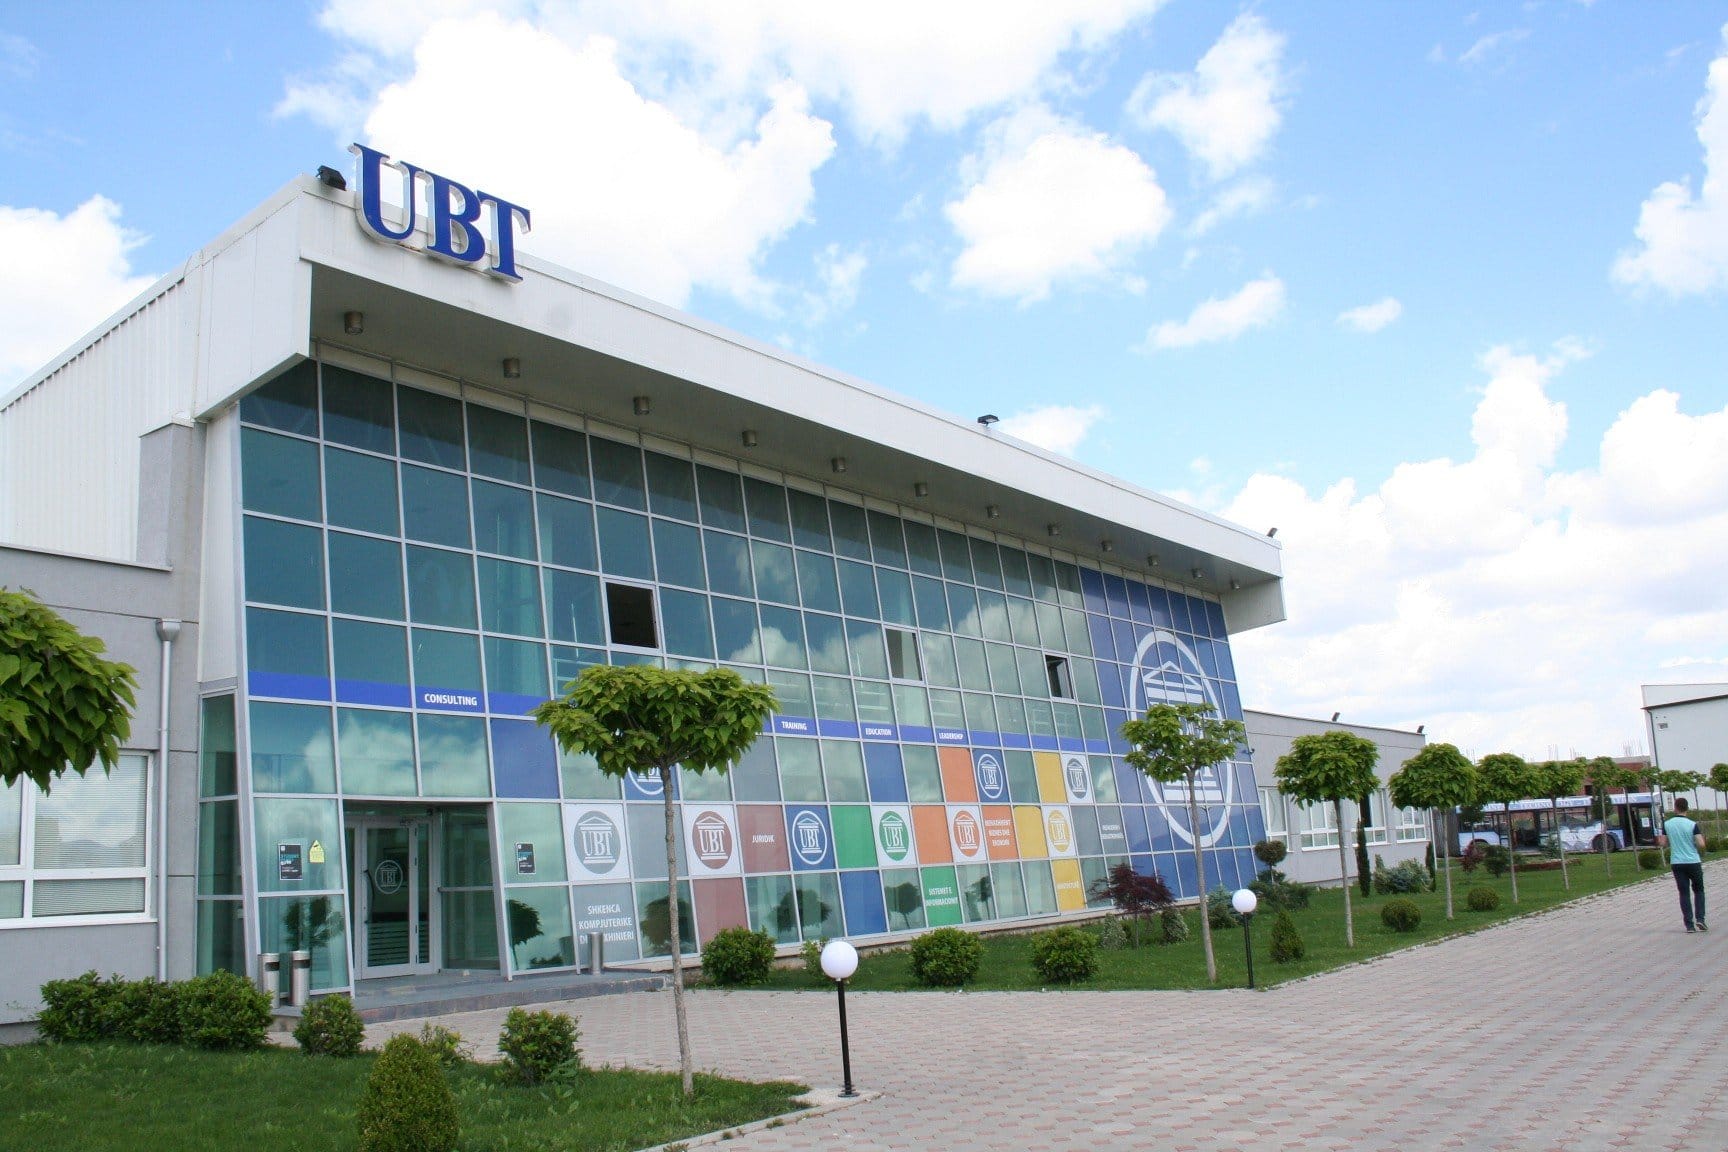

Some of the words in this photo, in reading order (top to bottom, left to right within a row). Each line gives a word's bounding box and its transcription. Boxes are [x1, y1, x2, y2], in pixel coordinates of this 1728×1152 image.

[349, 142, 531, 284] UBT
[424, 692, 478, 706] CONSULTING
[781, 720, 807, 731] TRAINING
[865, 727, 892, 737] EDUCATION
[982, 768, 998, 785] UBT
[581, 830, 613, 856] UBT
[699, 829, 725, 853] UBT
[799, 828, 820, 848] UBT
[883, 826, 904, 847] UBT
[957, 825, 975, 844] UBT
[588, 904, 620, 915] SHKENCA
